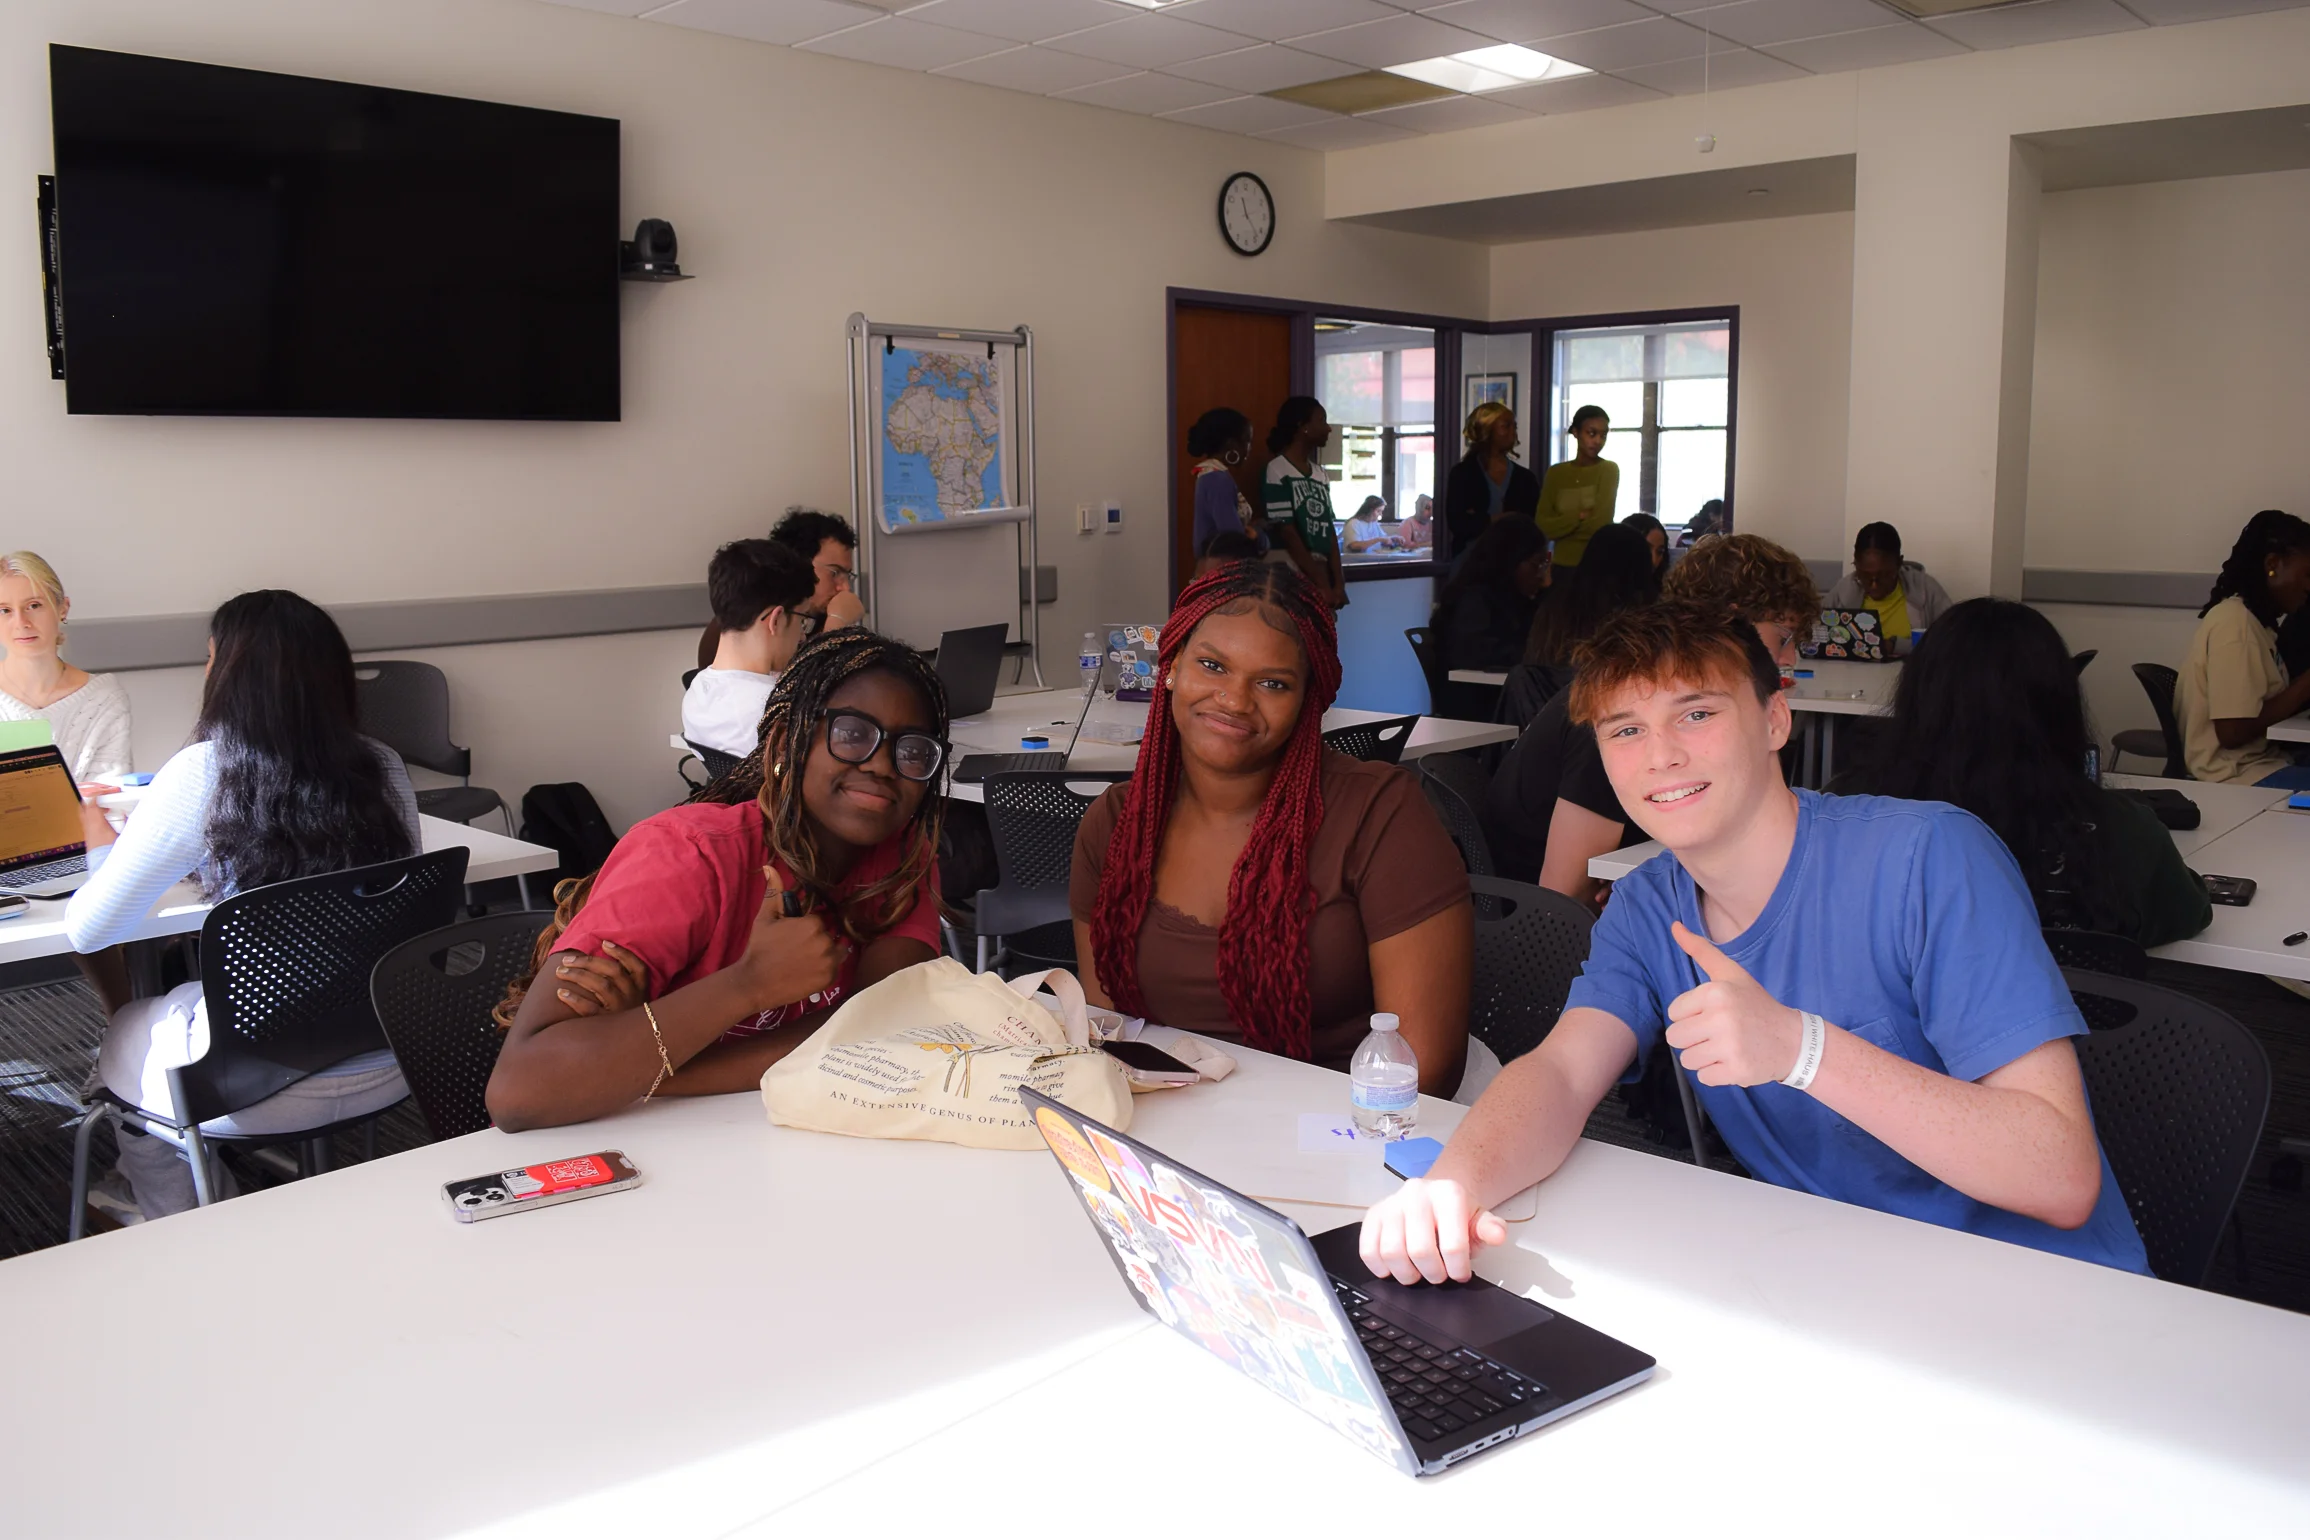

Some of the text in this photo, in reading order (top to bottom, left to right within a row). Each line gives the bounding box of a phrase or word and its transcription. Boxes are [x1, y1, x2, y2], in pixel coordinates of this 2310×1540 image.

[1291, 479, 1331, 511] ATHLETI
[1306, 517, 1329, 538] EPT
[821, 1053, 846, 1065] plant
[845, 1058, 852, 1067] is
[854, 1062, 881, 1076] widely
[881, 1071, 901, 1082] used
[867, 1055, 909, 1075] pharmacy,
[1027, 1060, 1066, 1072] harmacy.
[817, 1062, 844, 1077] dicinal
[842, 1071, 860, 1082] and
[858, 1077, 887, 1092] cosmetic
[999, 1070, 1065, 1086] momile pharmacy
[1046, 1081, 1065, 1093] give
[830, 1090, 848, 1102] AN
[852, 1096, 927, 1112] EXTENSIVE
[928, 1107, 973, 1122] GENUS
[978, 1115, 995, 1125] OF
[989, 1095, 1010, 1105] them
